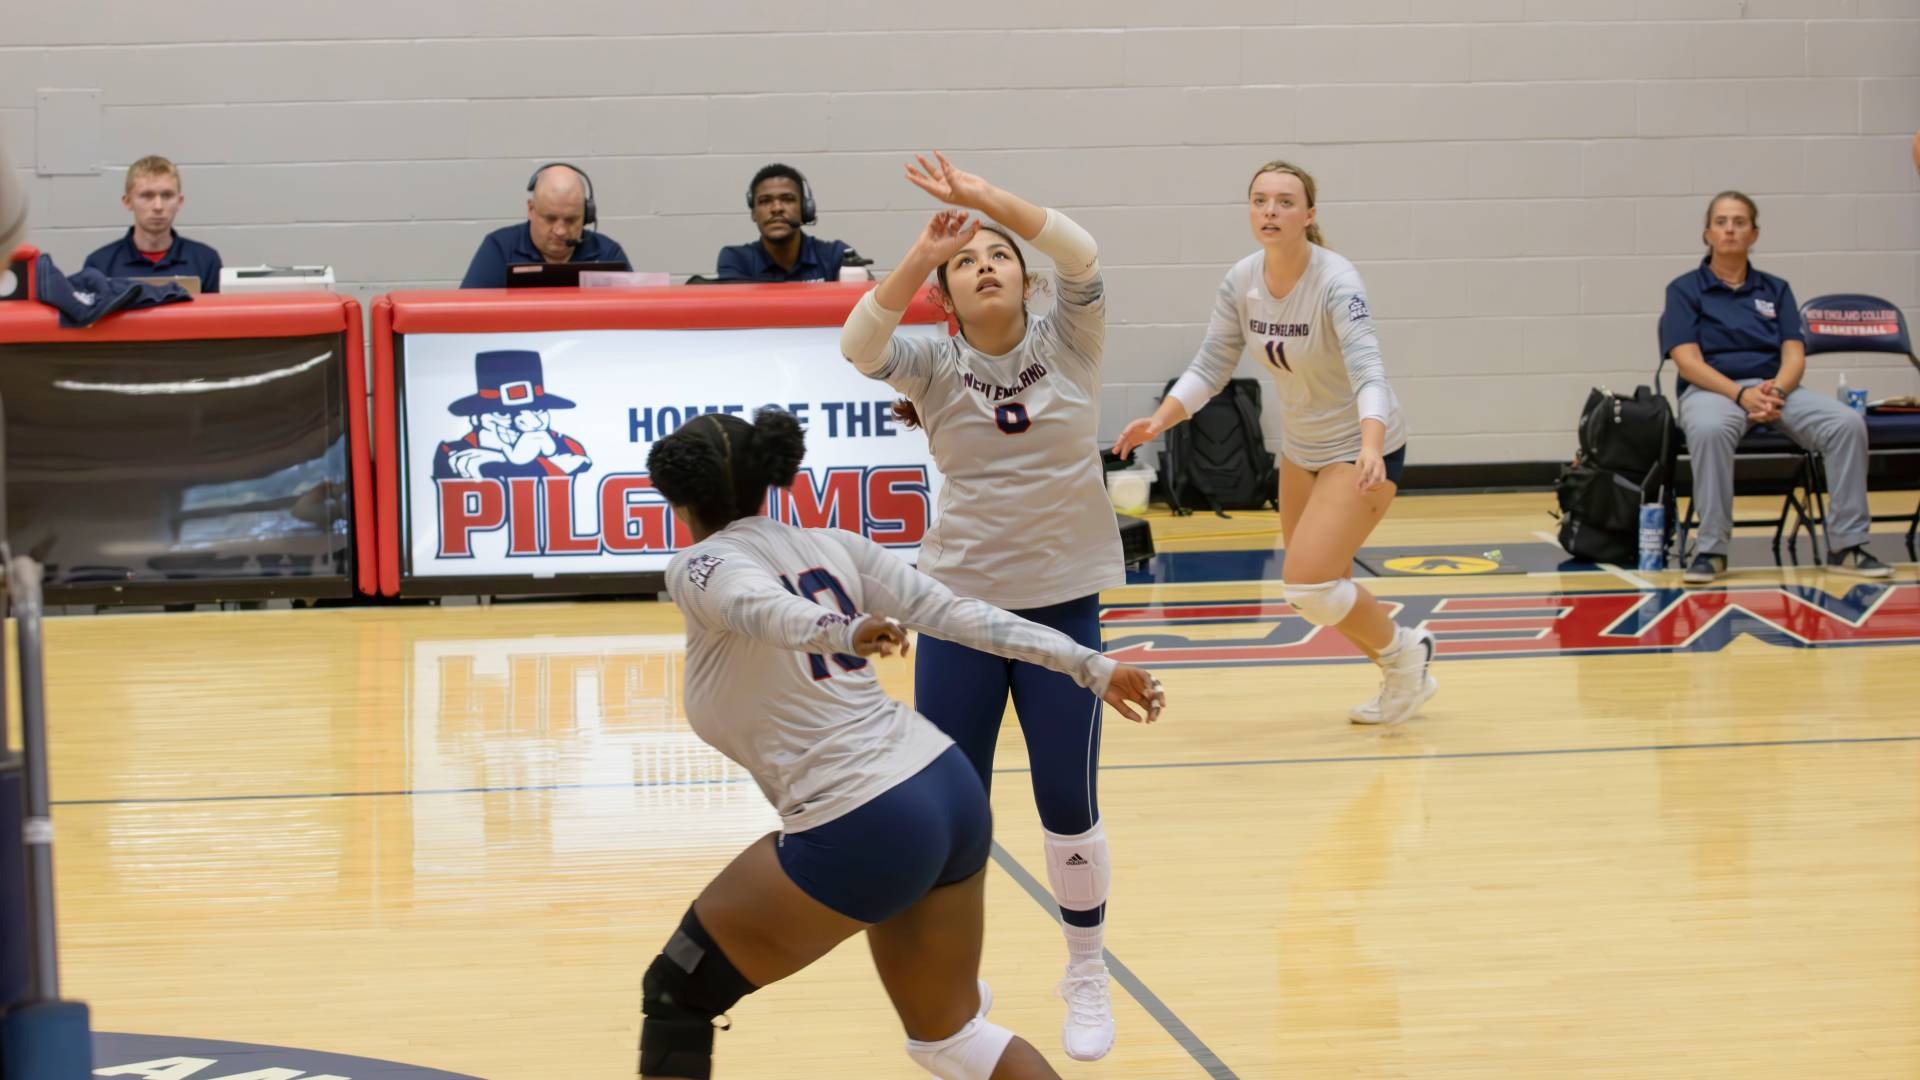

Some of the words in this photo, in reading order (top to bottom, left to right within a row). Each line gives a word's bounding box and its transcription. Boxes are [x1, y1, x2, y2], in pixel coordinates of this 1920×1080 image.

[1269, 323, 1309, 337] ENGLAND
[1819, 323, 1887, 336] BASKETBALL
[1264, 340, 1293, 374] 11
[628, 405, 744, 443] HO
[821, 401, 897, 438] THE
[433, 465, 931, 559] PILGMS
